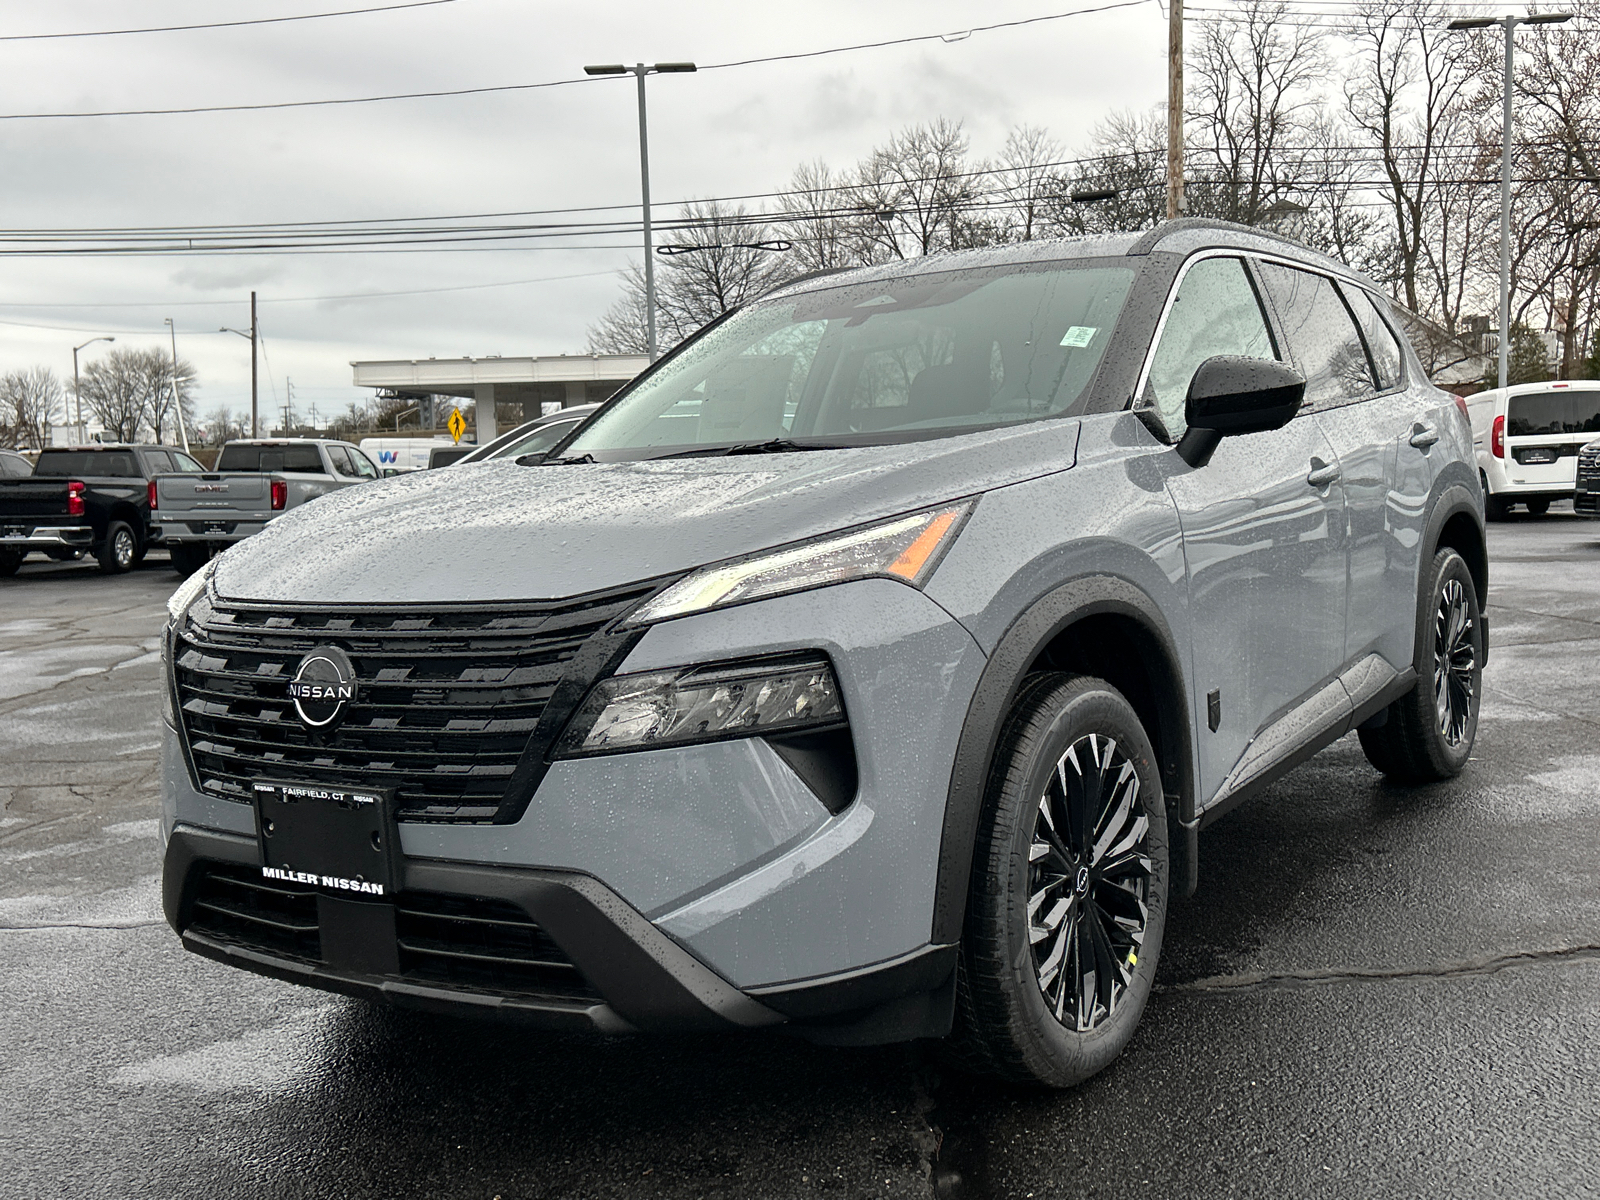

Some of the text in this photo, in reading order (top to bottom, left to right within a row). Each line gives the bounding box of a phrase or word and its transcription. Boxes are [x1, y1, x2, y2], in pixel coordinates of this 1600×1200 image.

[194, 484, 229, 493] GMC
[289, 684, 352, 698] NISSAN
[282, 787, 345, 801] FAIRFIELD, CT
[353, 795, 374, 803] NISSAN
[262, 866, 384, 895] MILLER NISSAN
